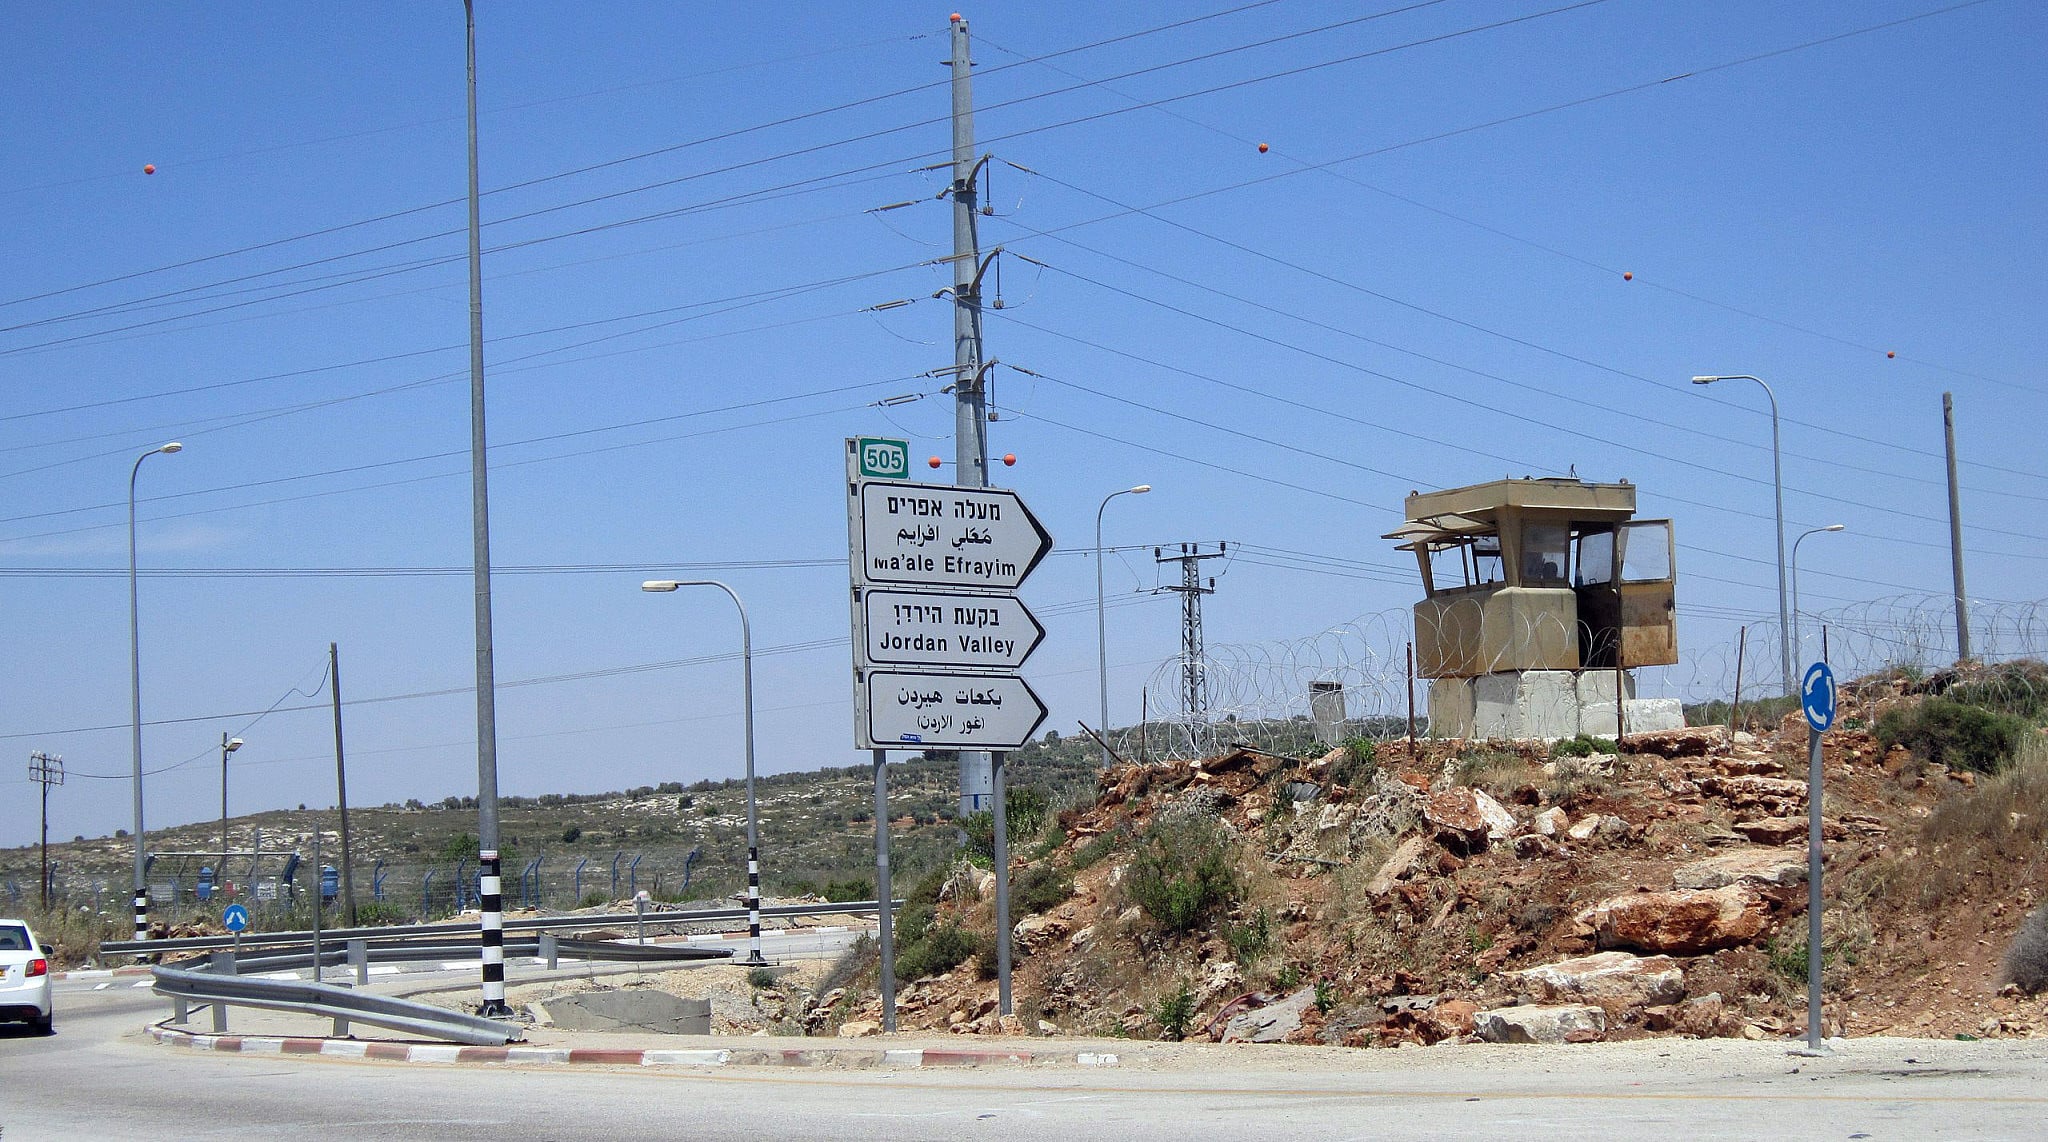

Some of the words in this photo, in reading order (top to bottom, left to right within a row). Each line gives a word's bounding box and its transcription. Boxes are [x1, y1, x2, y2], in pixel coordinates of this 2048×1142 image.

[867, 448, 903, 470] 505
[887, 496, 943, 518] אפרים
[954, 499, 1001, 521] מעלה
[896, 523, 939, 548] افرايم
[944, 555, 1016, 579] Efrayim
[953, 607, 1000, 629] בקעת
[880, 631, 948, 652] Jordan
[958, 635, 1015, 658] Valley
[897, 687, 943, 710] هيردن
[955, 687, 1003, 710] بكعات
